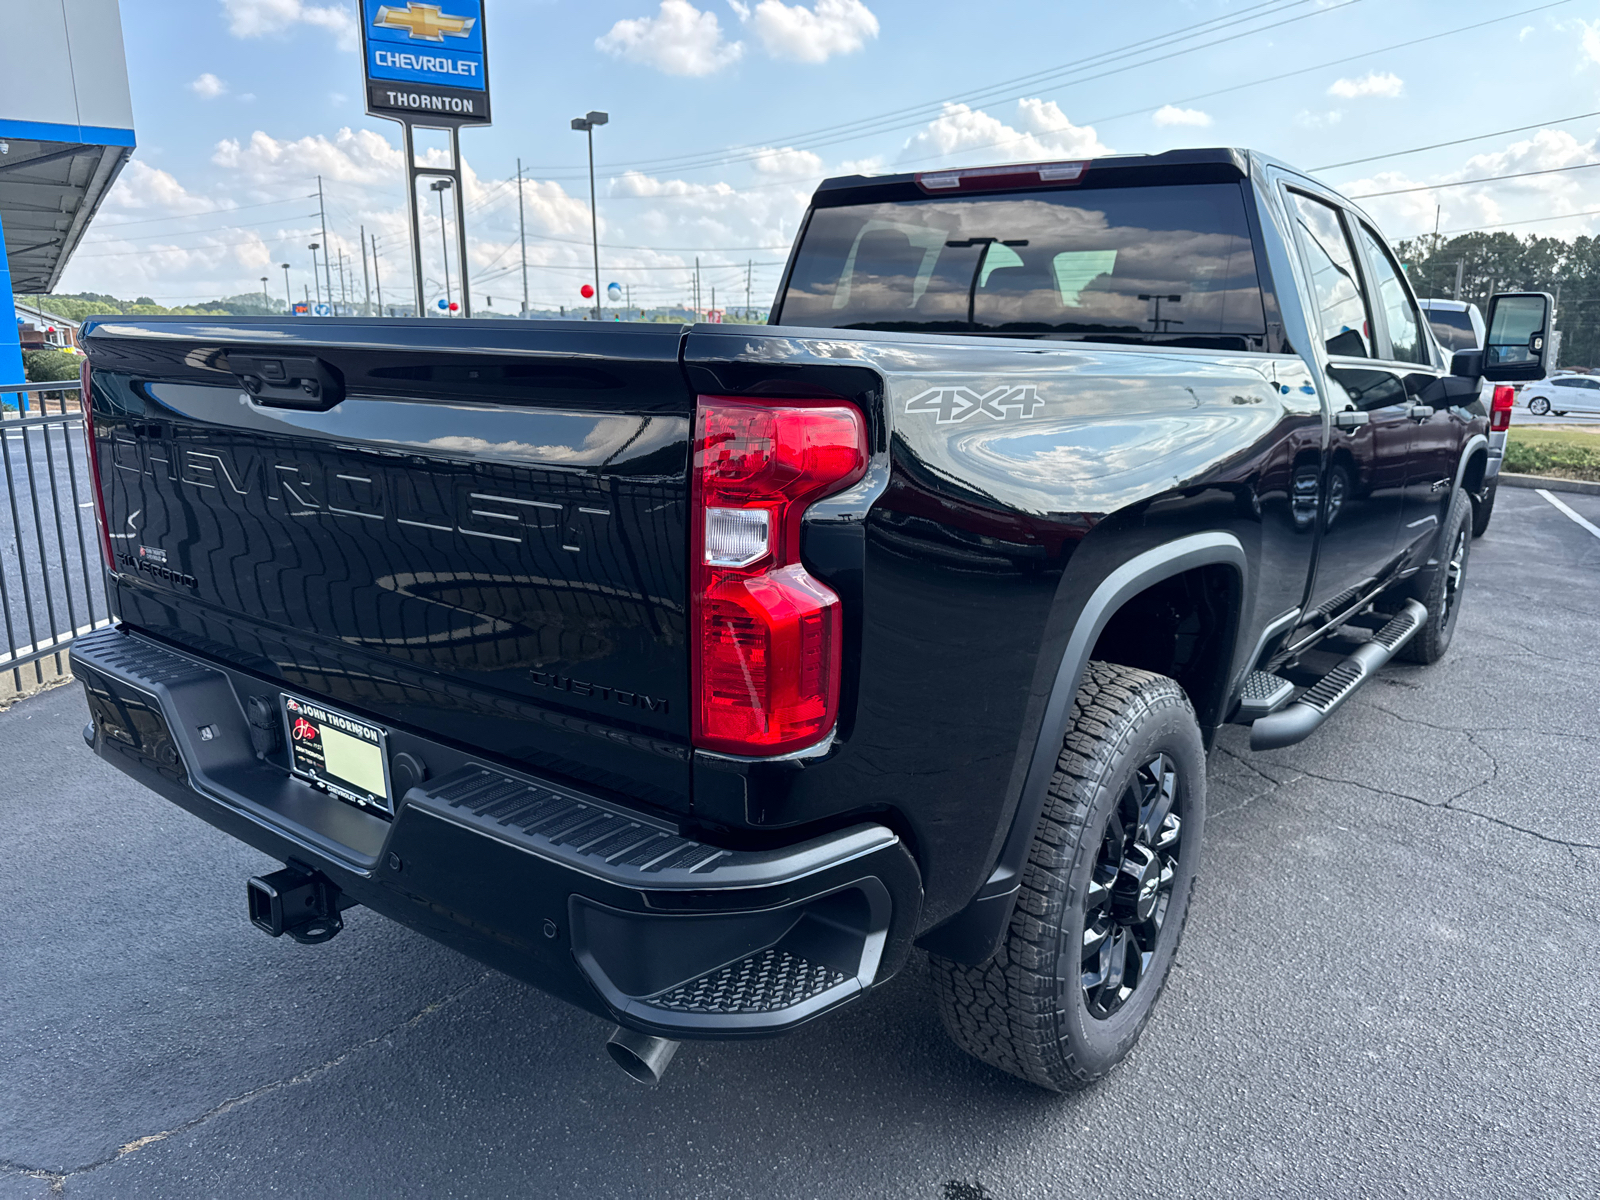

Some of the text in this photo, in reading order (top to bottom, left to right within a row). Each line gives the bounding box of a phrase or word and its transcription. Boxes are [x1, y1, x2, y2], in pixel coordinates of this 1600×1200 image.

[375, 51, 478, 76] CHEVROLET
[387, 91, 473, 113] THORNTON
[905, 385, 1045, 424] 4X4
[113, 436, 612, 552] CHEVROLET
[530, 669, 669, 714] CUSTOM
[303, 704, 327, 722] JOHN
[327, 714, 378, 742] THORNTON
[326, 785, 356, 802] CHEVROLET
